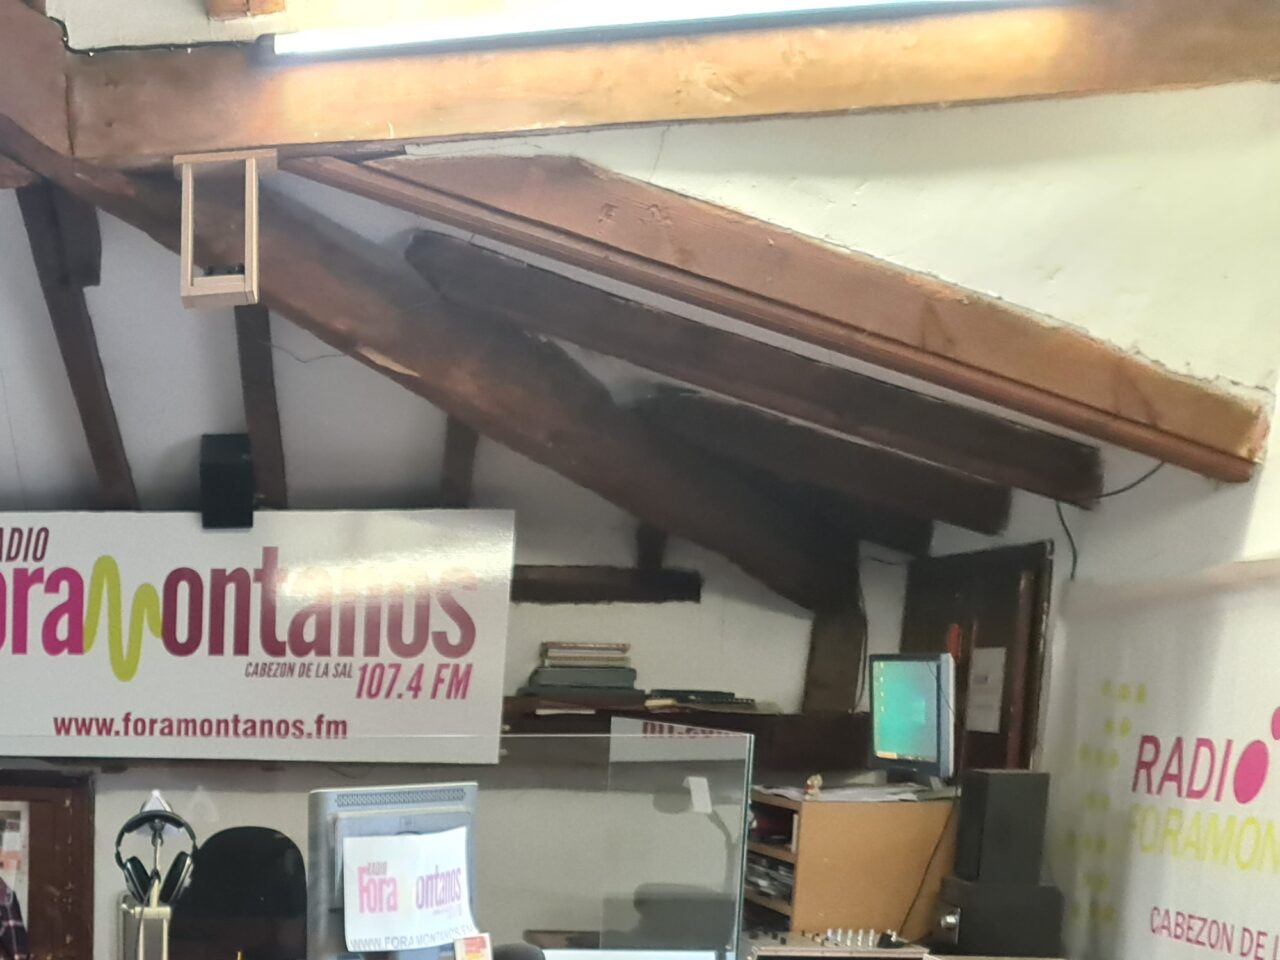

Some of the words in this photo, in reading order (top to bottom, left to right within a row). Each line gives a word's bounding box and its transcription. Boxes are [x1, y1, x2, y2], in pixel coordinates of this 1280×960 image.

[244, 661, 295, 678] CABEZON
[297, 662, 312, 678] DE
[314, 662, 329, 679] LA
[332, 662, 354, 679] SAL
[355, 662, 424, 700] 107.4
[430, 663, 473, 700] FM
[53, 712, 348, 740] www.foramontanos.fm
[1131, 734, 1269, 805] RADIO
[1150, 906, 1235, 954] CABEZON
